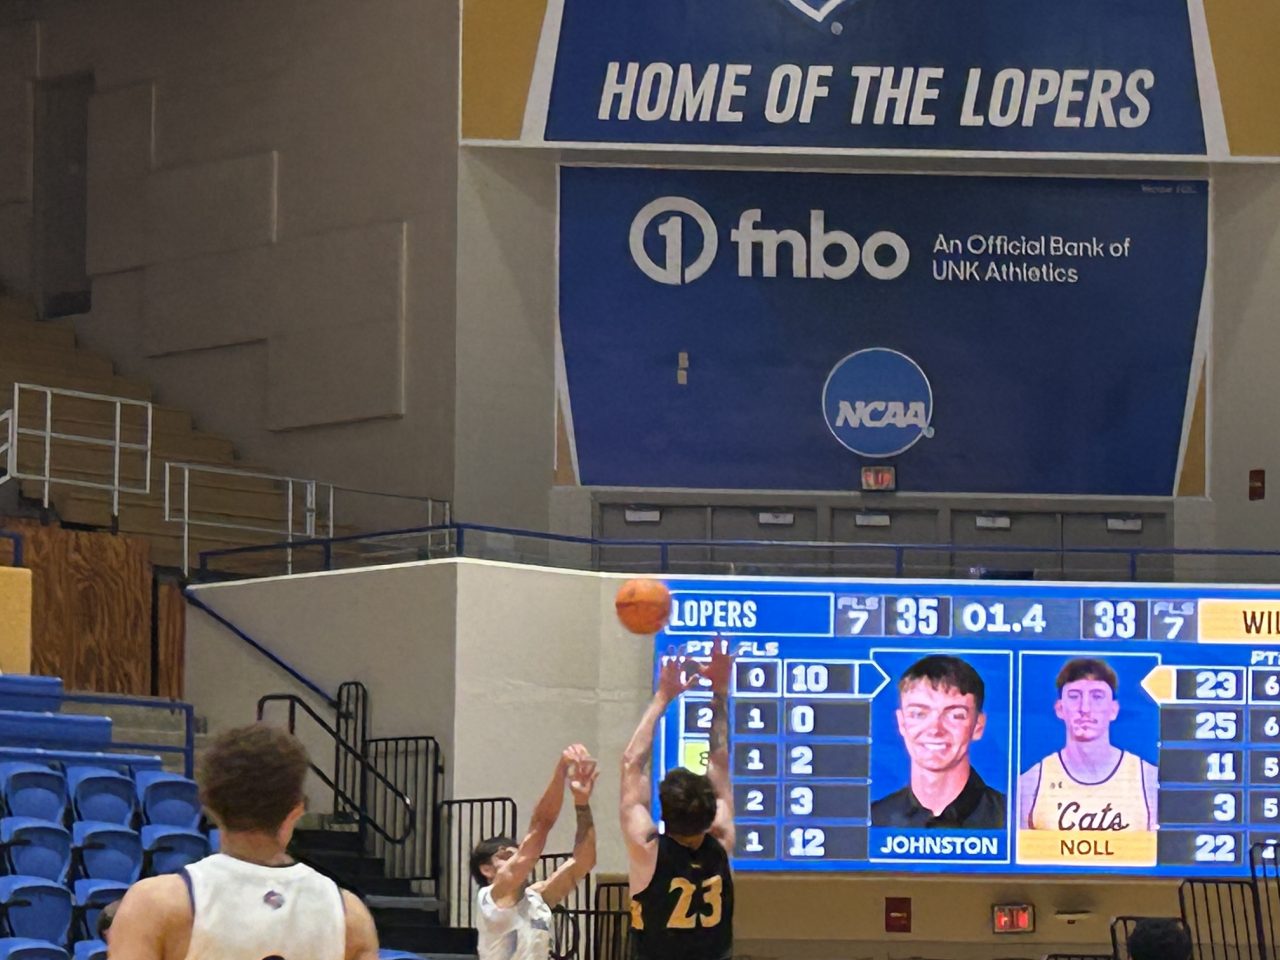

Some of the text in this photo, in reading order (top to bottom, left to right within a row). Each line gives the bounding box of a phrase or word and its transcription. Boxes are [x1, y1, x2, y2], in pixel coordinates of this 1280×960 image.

[598, 61, 1155, 129] HOME OF THE LOPERS
[730, 208, 910, 281] fnbo
[933, 233, 1131, 257] An Official Bank of
[932, 259, 1079, 283] UNK Athletics
[835, 400, 929, 428] NCAA
[670, 600, 758, 628] LOPERS
[837, 596, 880, 610] FLS
[896, 597, 939, 635] 35
[961, 602, 1047, 633] 01.4
[1153, 601, 1194, 616] FLS
[848, 610, 869, 635] 7
[1094, 600, 1136, 639] 33
[1163, 616, 1185, 640] 7
[749, 664, 829, 693] 0 10
[1195, 670, 1237, 700] 23
[1264, 675, 1280, 697] 6
[747, 707, 765, 729] 1
[792, 705, 815, 734] 0
[1195, 711, 1237, 740] 25
[1263, 716, 1280, 737] 6
[747, 748, 765, 770] 1
[790, 745, 814, 775] 2
[1206, 752, 1237, 781] 11
[1264, 756, 1280, 778] 5
[746, 786, 814, 815] 2 3
[1213, 792, 1236, 821] 3
[1263, 797, 1279, 818] 5
[745, 827, 826, 857] 1 12
[880, 835, 1115, 856] JOHNSTON NOLL
[1195, 834, 1236, 863] 22
[666, 874, 723, 929] 23
